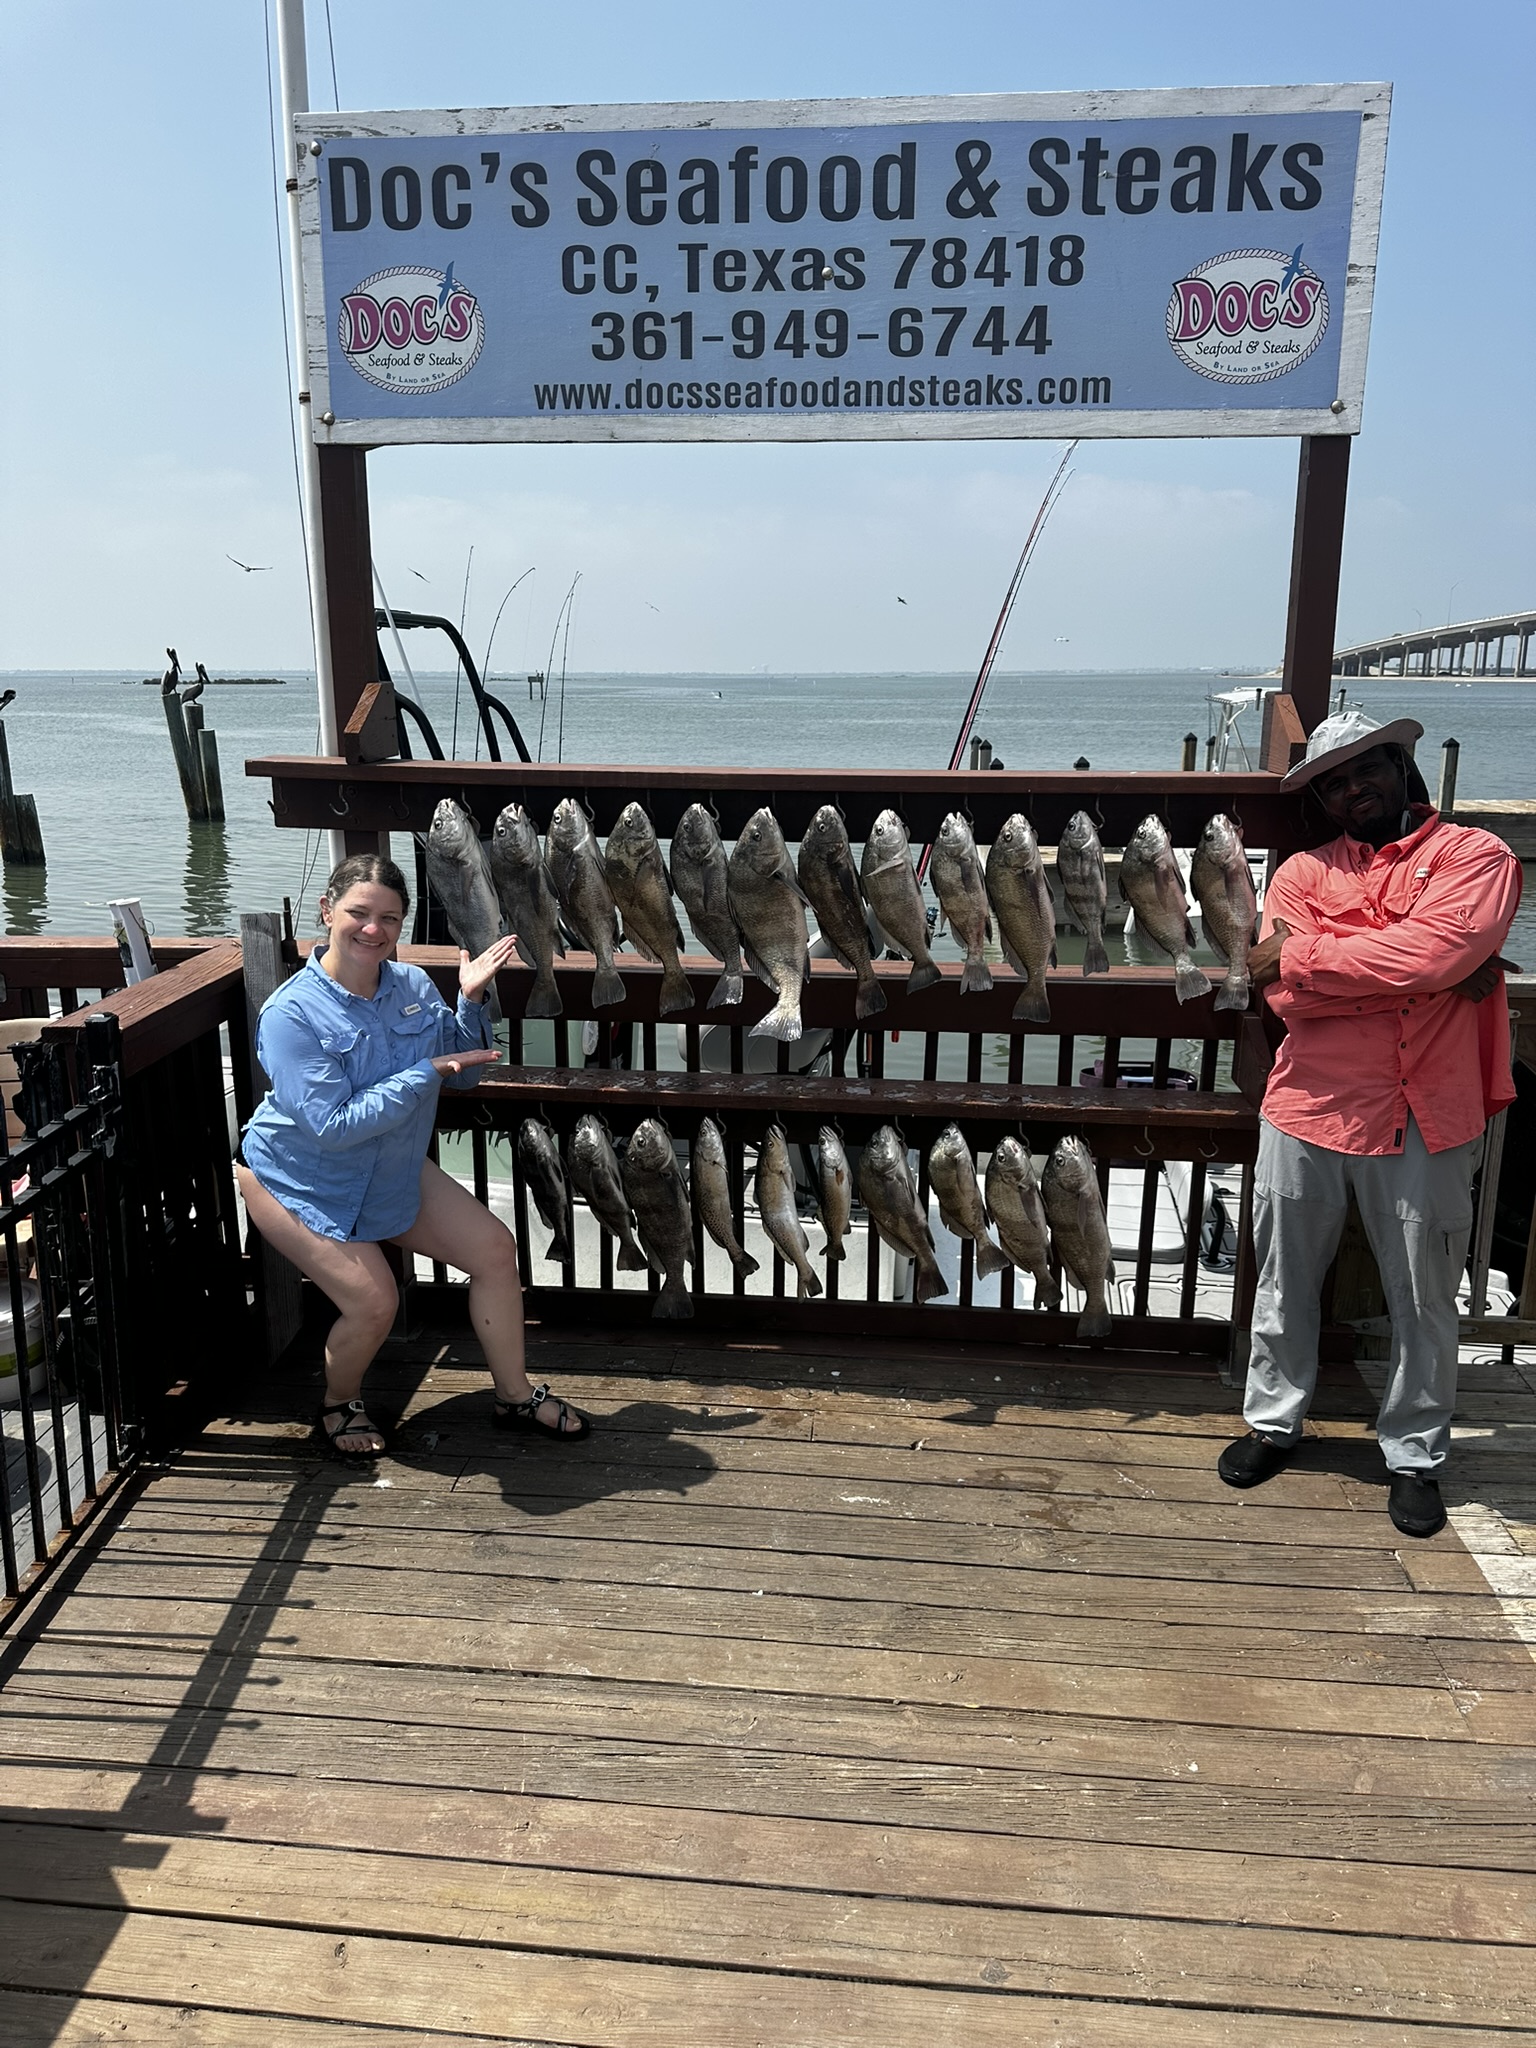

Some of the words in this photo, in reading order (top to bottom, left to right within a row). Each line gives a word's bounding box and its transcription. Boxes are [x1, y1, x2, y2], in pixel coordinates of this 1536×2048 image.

[328, 152, 551, 232] Doc's
[575, 142, 917, 229] Seafood
[945, 140, 1001, 219] &
[1026, 133, 1324, 217] Steaks
[561, 243, 659, 303] CC,
[677, 242, 867, 293] Texas
[890, 234, 1085, 290] 78418
[590, 304, 1053, 361] 361-949-6744
[1195, 340, 1243, 357] Seafood
[1246, 340, 1259, 354] &
[1263, 339, 1301, 354] Steaks
[368, 353, 411, 369] Seafood
[414, 353, 426, 366] &
[429, 352, 463, 366] Steaks
[534, 375, 1112, 410] www.docsseafoodandsteaks.com
